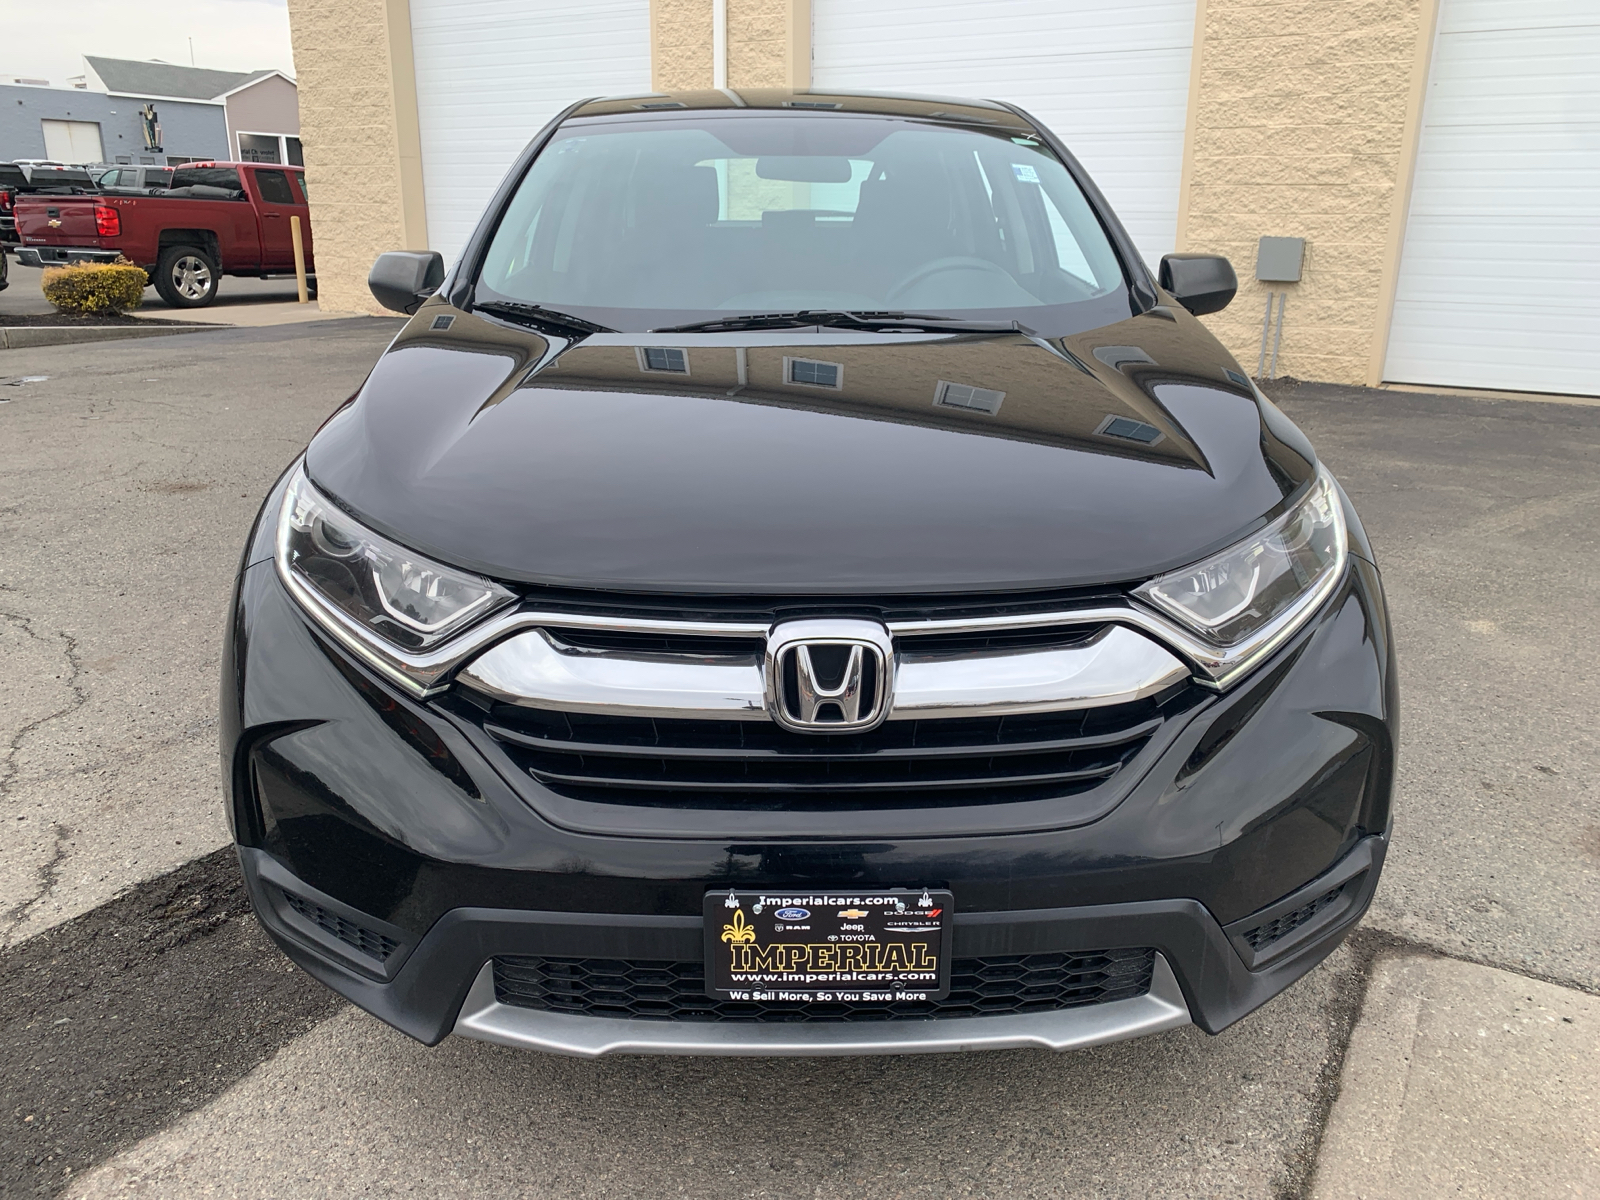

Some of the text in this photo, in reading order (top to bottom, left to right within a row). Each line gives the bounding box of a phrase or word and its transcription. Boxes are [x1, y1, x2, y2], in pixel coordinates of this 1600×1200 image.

[759, 895, 899, 907] Imperialcars.com
[782, 909, 802, 918] Ford
[840, 922, 864, 932] Jeep
[840, 934, 876, 942] TOYOTA
[730, 943, 937, 972] IMPERIAL
[730, 972, 936, 983] www.imperialcars.com
[729, 991, 926, 1002] We Sell More, So You Save More
